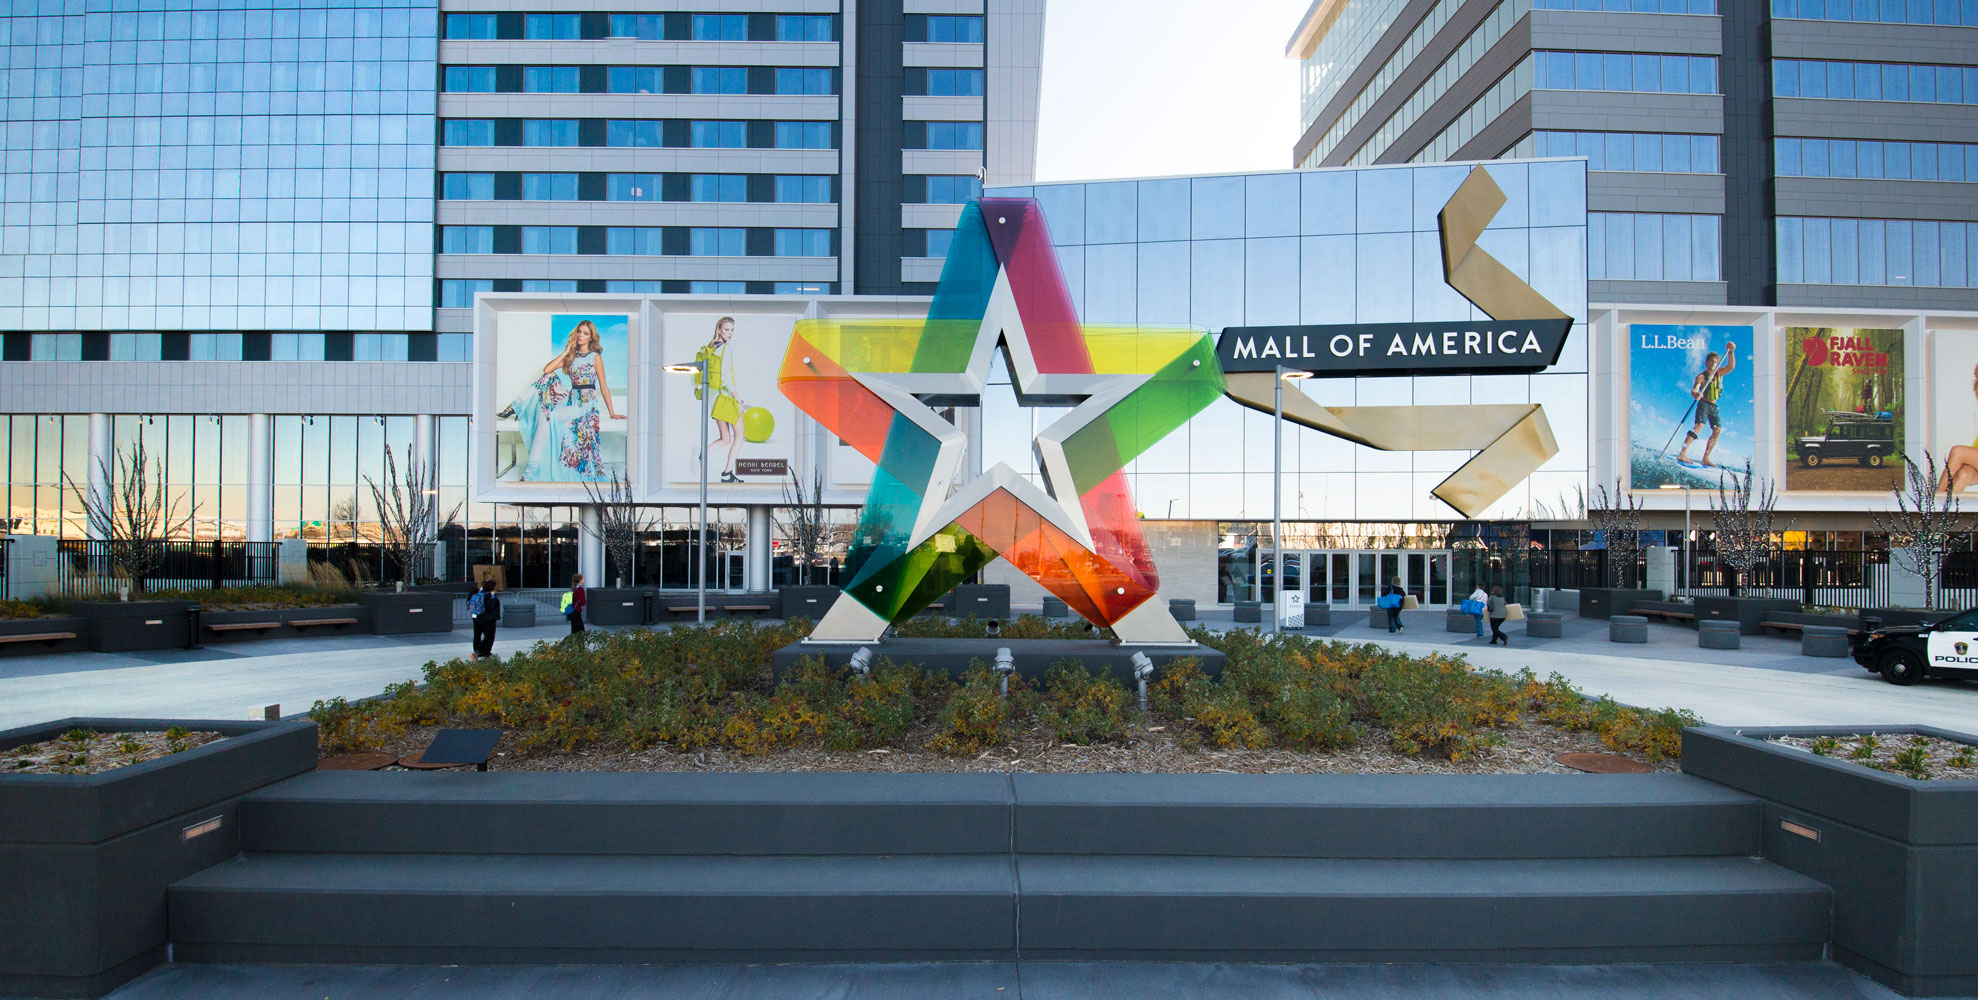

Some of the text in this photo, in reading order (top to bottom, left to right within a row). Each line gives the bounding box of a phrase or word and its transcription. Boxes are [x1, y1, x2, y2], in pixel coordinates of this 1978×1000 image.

[1233, 329, 1543, 359] MALL OF AMERICA
[1641, 334, 1706, 350] L.L.Bean
